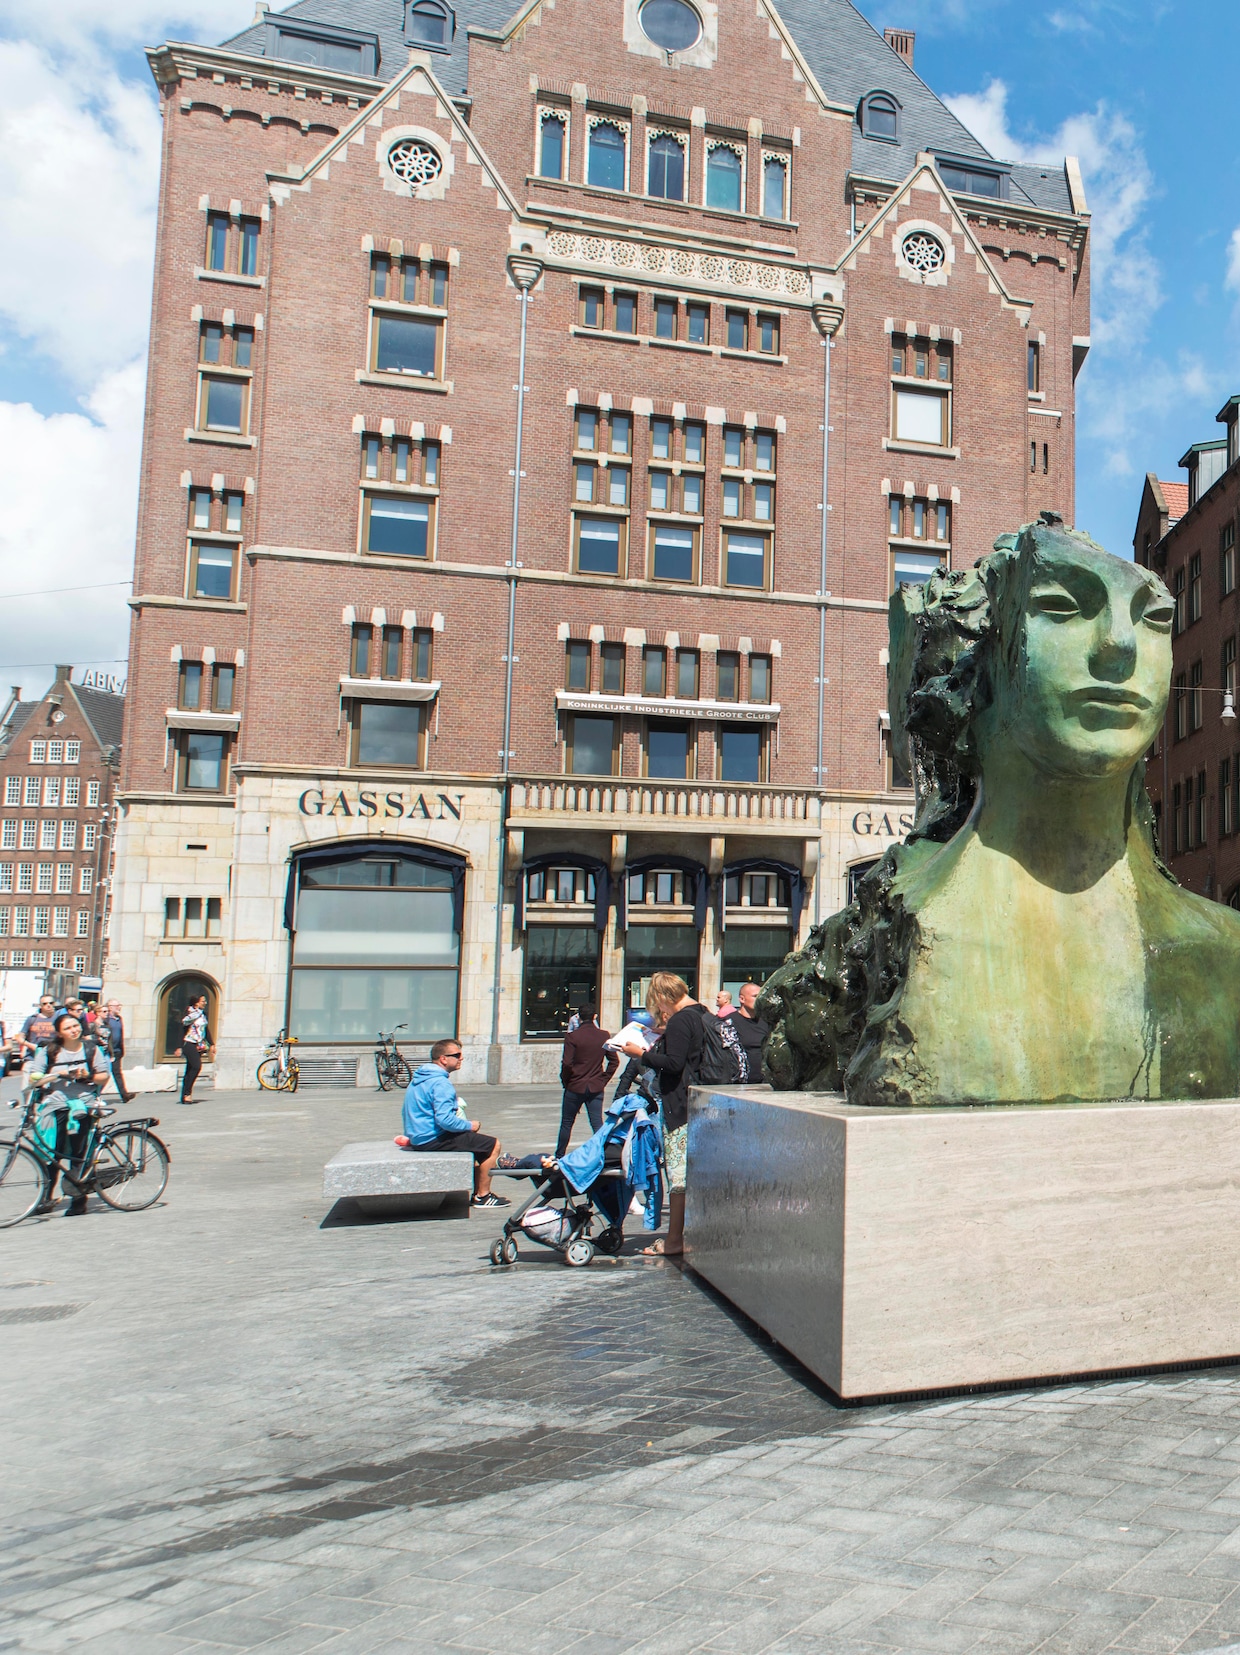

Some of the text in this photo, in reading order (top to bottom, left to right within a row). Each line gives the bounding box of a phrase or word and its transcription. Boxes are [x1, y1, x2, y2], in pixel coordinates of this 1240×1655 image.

[567, 700, 771, 720] KONINKLIJKE INDUSTRIEELE GROOTE CLUB
[298, 788, 466, 821] GASSAN
